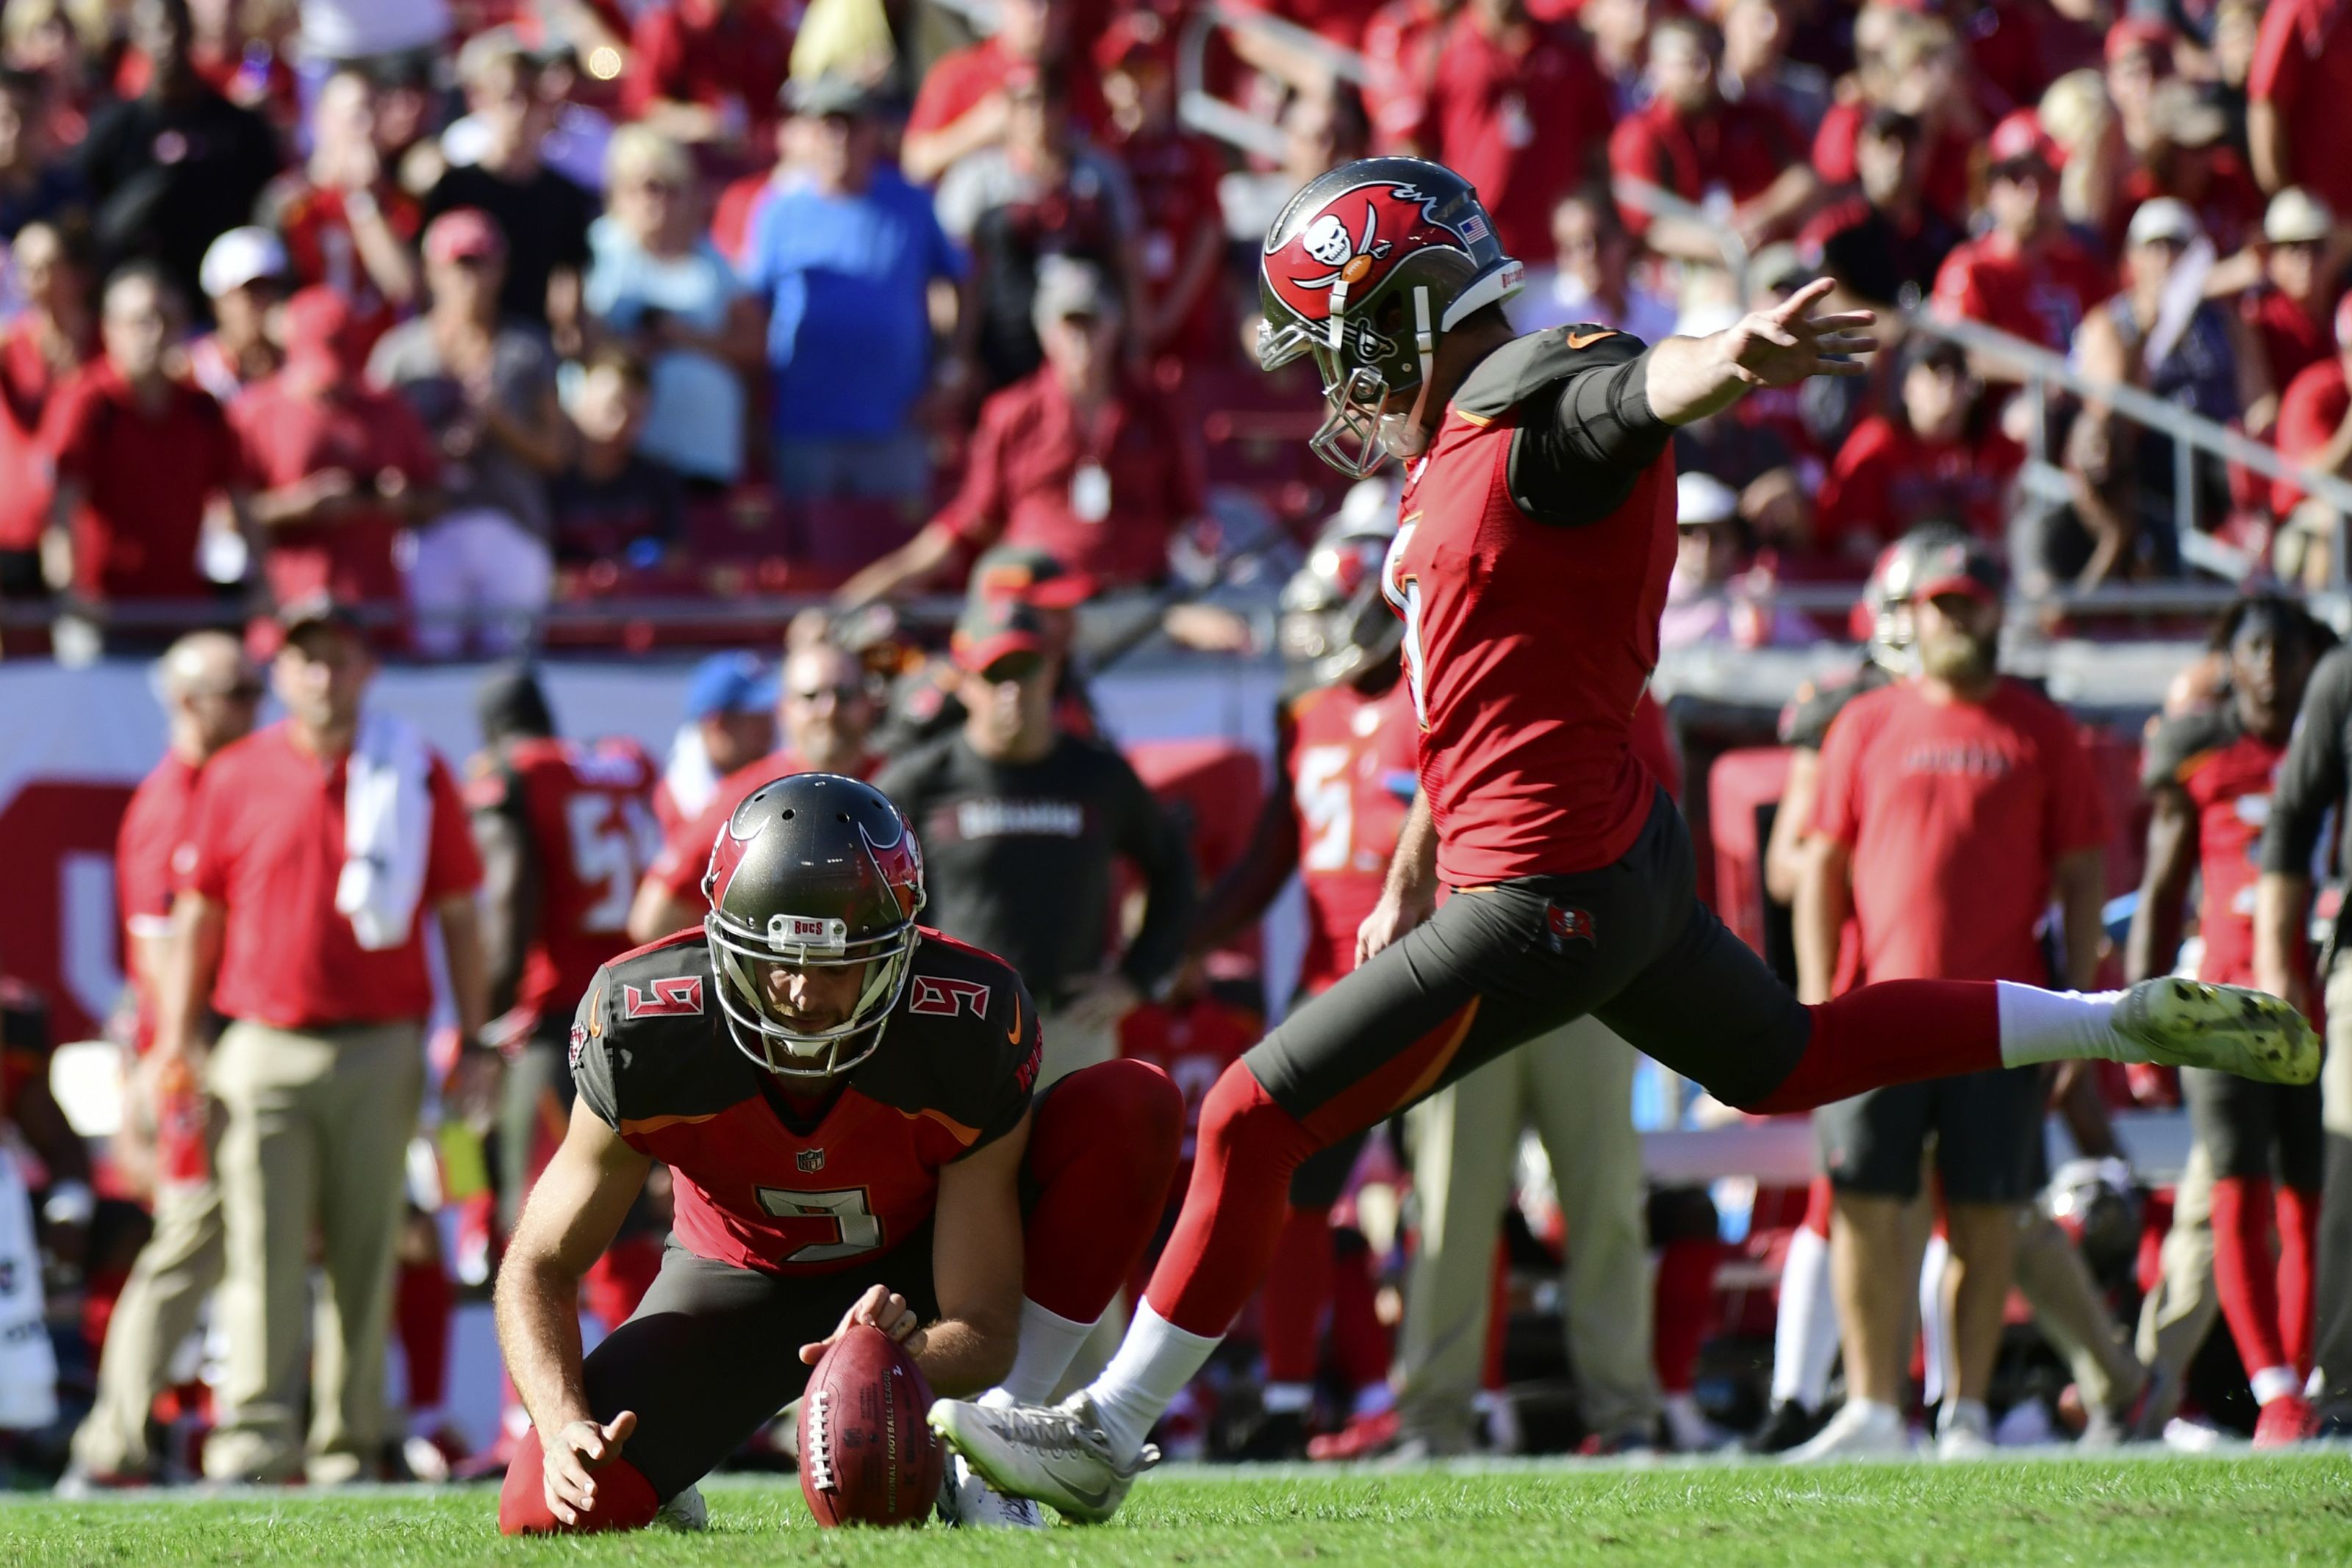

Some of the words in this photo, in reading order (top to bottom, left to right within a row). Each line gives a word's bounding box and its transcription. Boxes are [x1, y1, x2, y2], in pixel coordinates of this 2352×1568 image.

[795, 920, 822, 935] BUCS
[751, 1183, 886, 1265] 9
[882, 1369, 894, 1405] LEAGUE
[886, 1407, 897, 1461] FOOTBALL
[887, 1464, 897, 1514] NATIONAL
